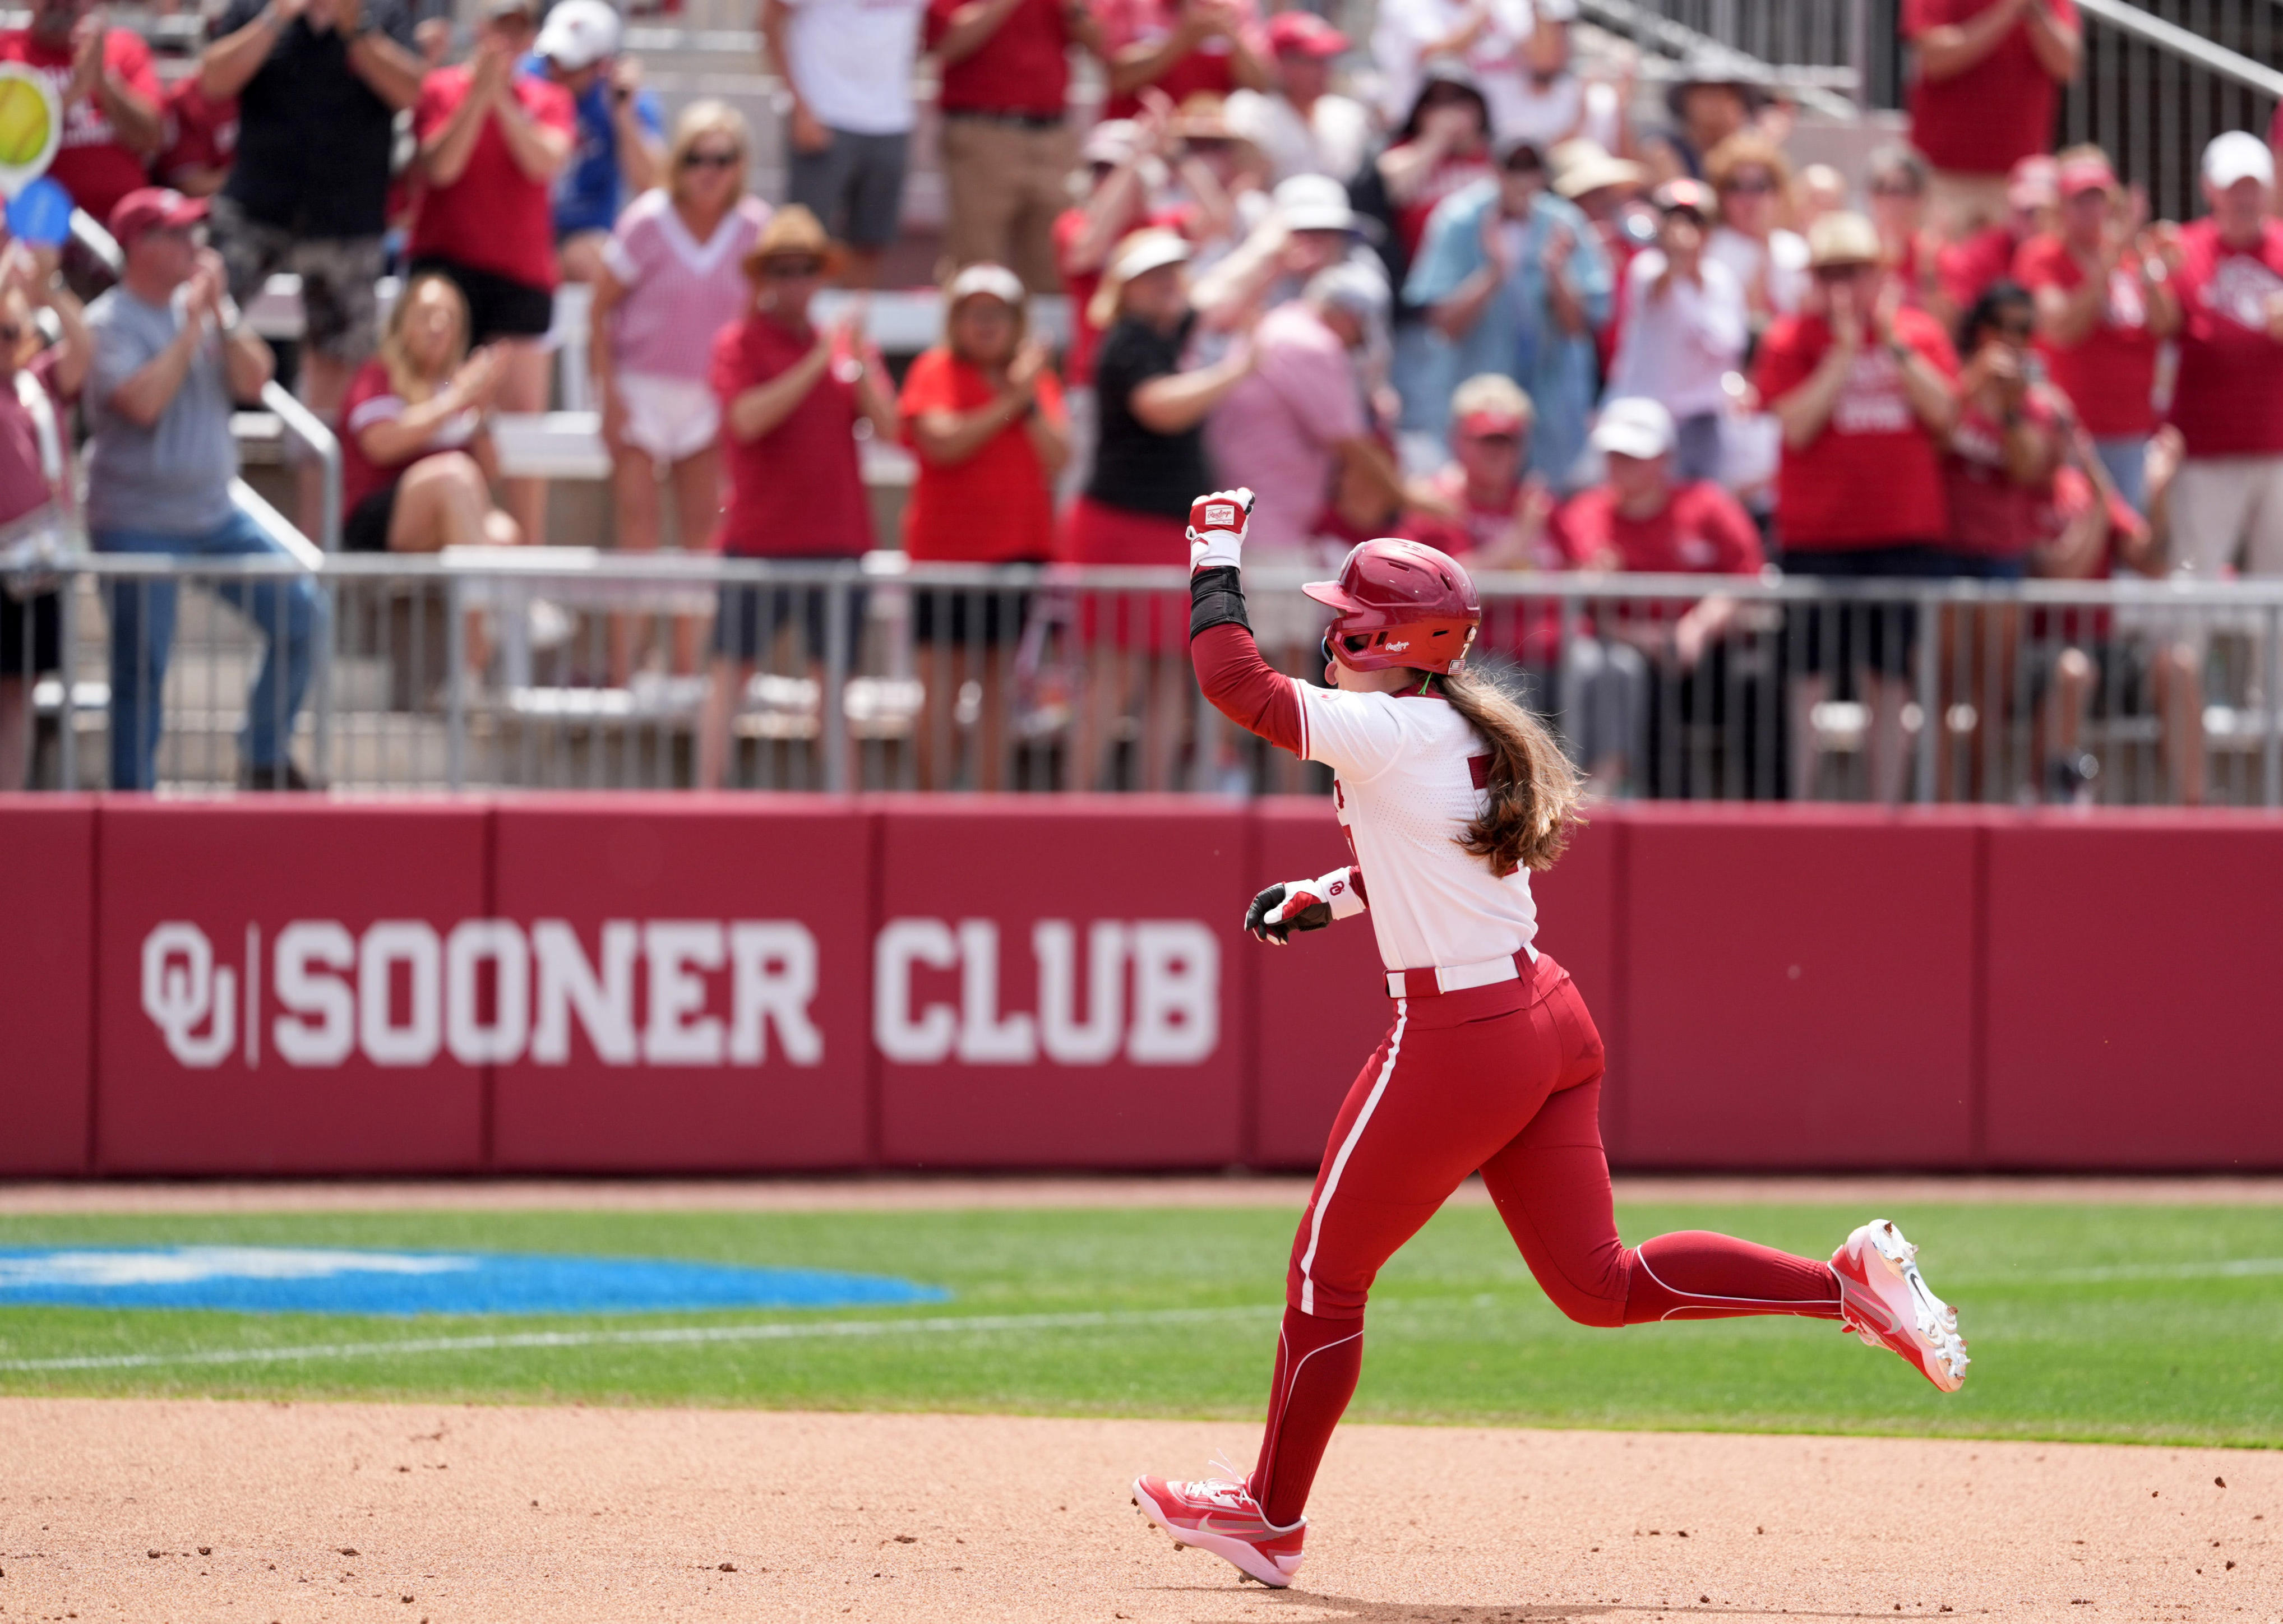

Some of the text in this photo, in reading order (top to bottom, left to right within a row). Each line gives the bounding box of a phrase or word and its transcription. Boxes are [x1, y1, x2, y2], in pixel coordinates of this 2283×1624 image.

[1207, 510, 1231, 520] Rawlings
[1385, 641, 1409, 651] Rawlings
[141, 919, 1219, 1067] OU SOONER CLUB
